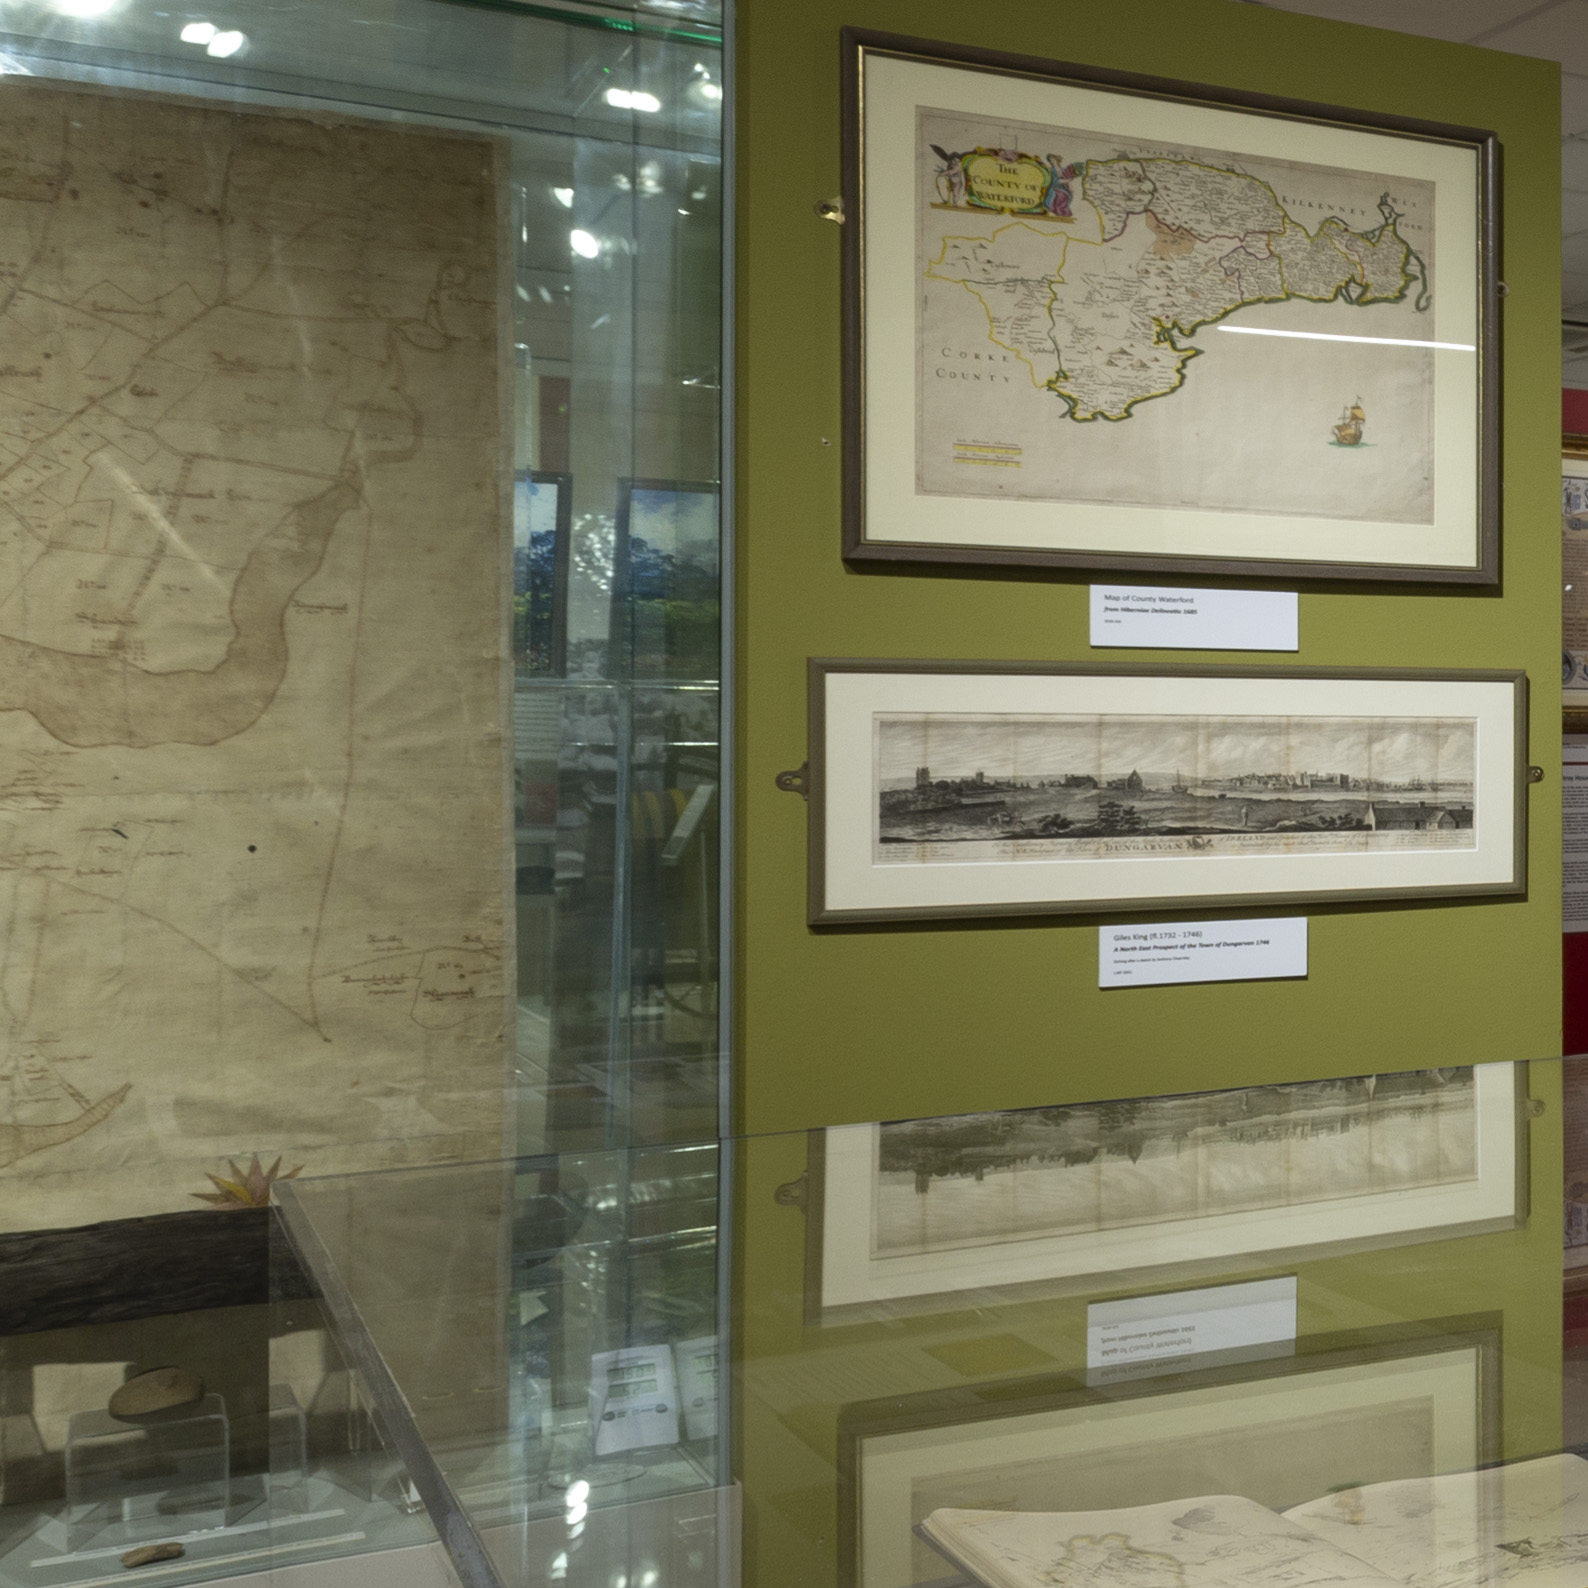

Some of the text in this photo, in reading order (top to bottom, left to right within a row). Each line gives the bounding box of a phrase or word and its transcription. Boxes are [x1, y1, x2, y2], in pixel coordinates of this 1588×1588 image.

[972, 175, 1020, 190] COUNTY
[975, 190, 1035, 205] WATERFORD
[941, 347, 1009, 363] CORKE
[935, 368, 1010, 383] COUNTY
[1103, 594, 1121, 602] Map
[1130, 594, 1157, 603] County
[1157, 596, 1194, 604] Waterford
[1105, 842, 1183, 854] DUNGARVAN
[1132, 933, 1148, 941] King
